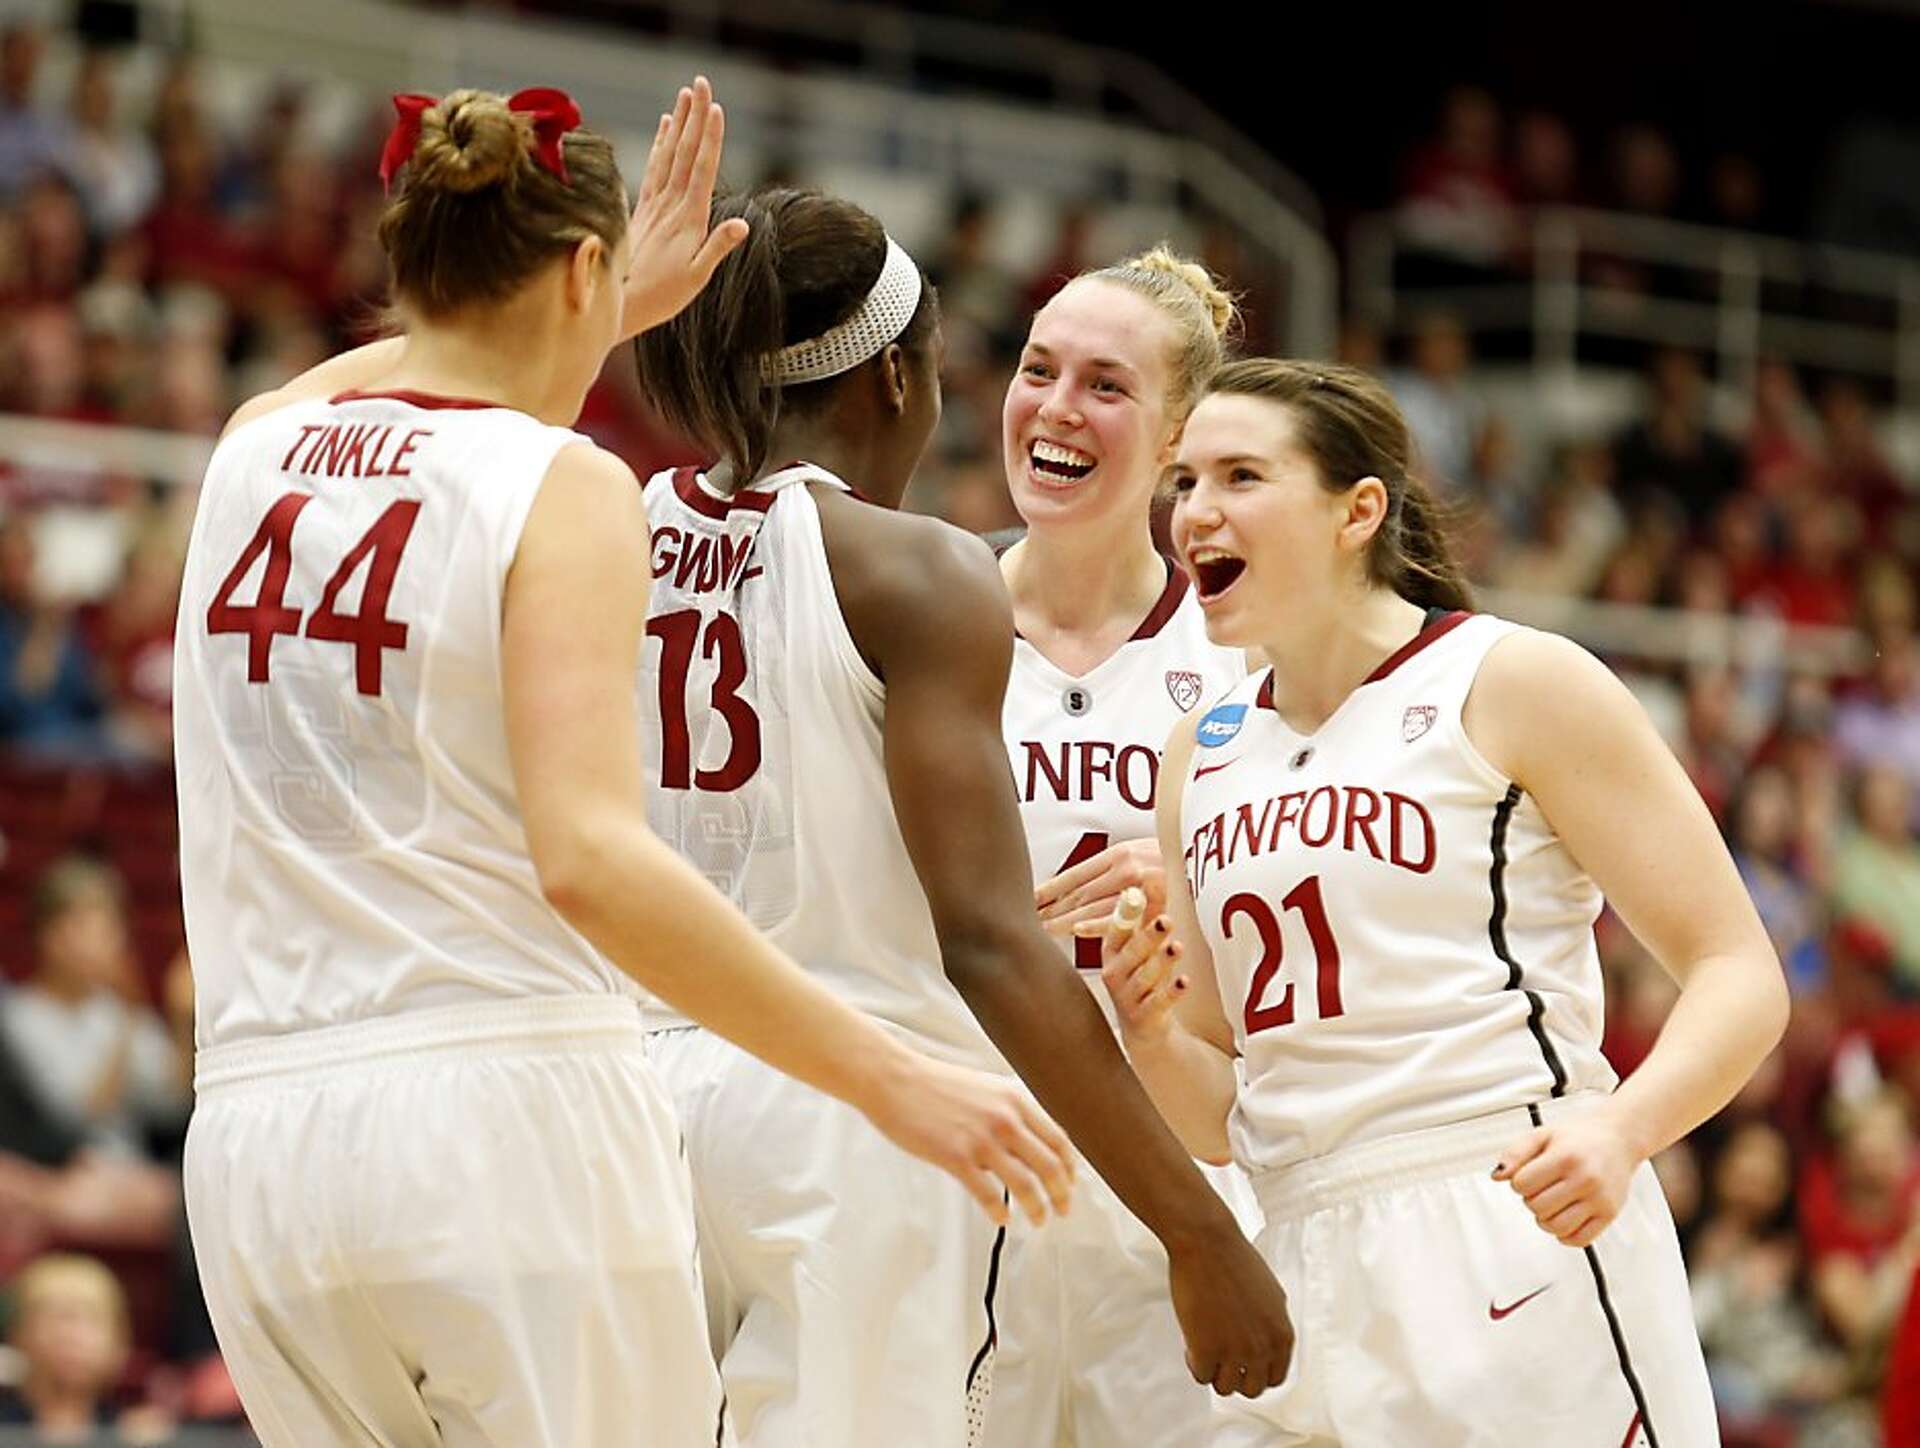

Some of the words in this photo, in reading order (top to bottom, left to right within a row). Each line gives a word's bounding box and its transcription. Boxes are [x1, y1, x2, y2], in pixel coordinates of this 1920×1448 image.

[280, 425, 434, 478] TINKLE
[206, 493, 422, 698] 44
[645, 608, 762, 793] 13
[1010, 740, 1163, 811] NFO
[1220, 875, 1345, 1036] 21
